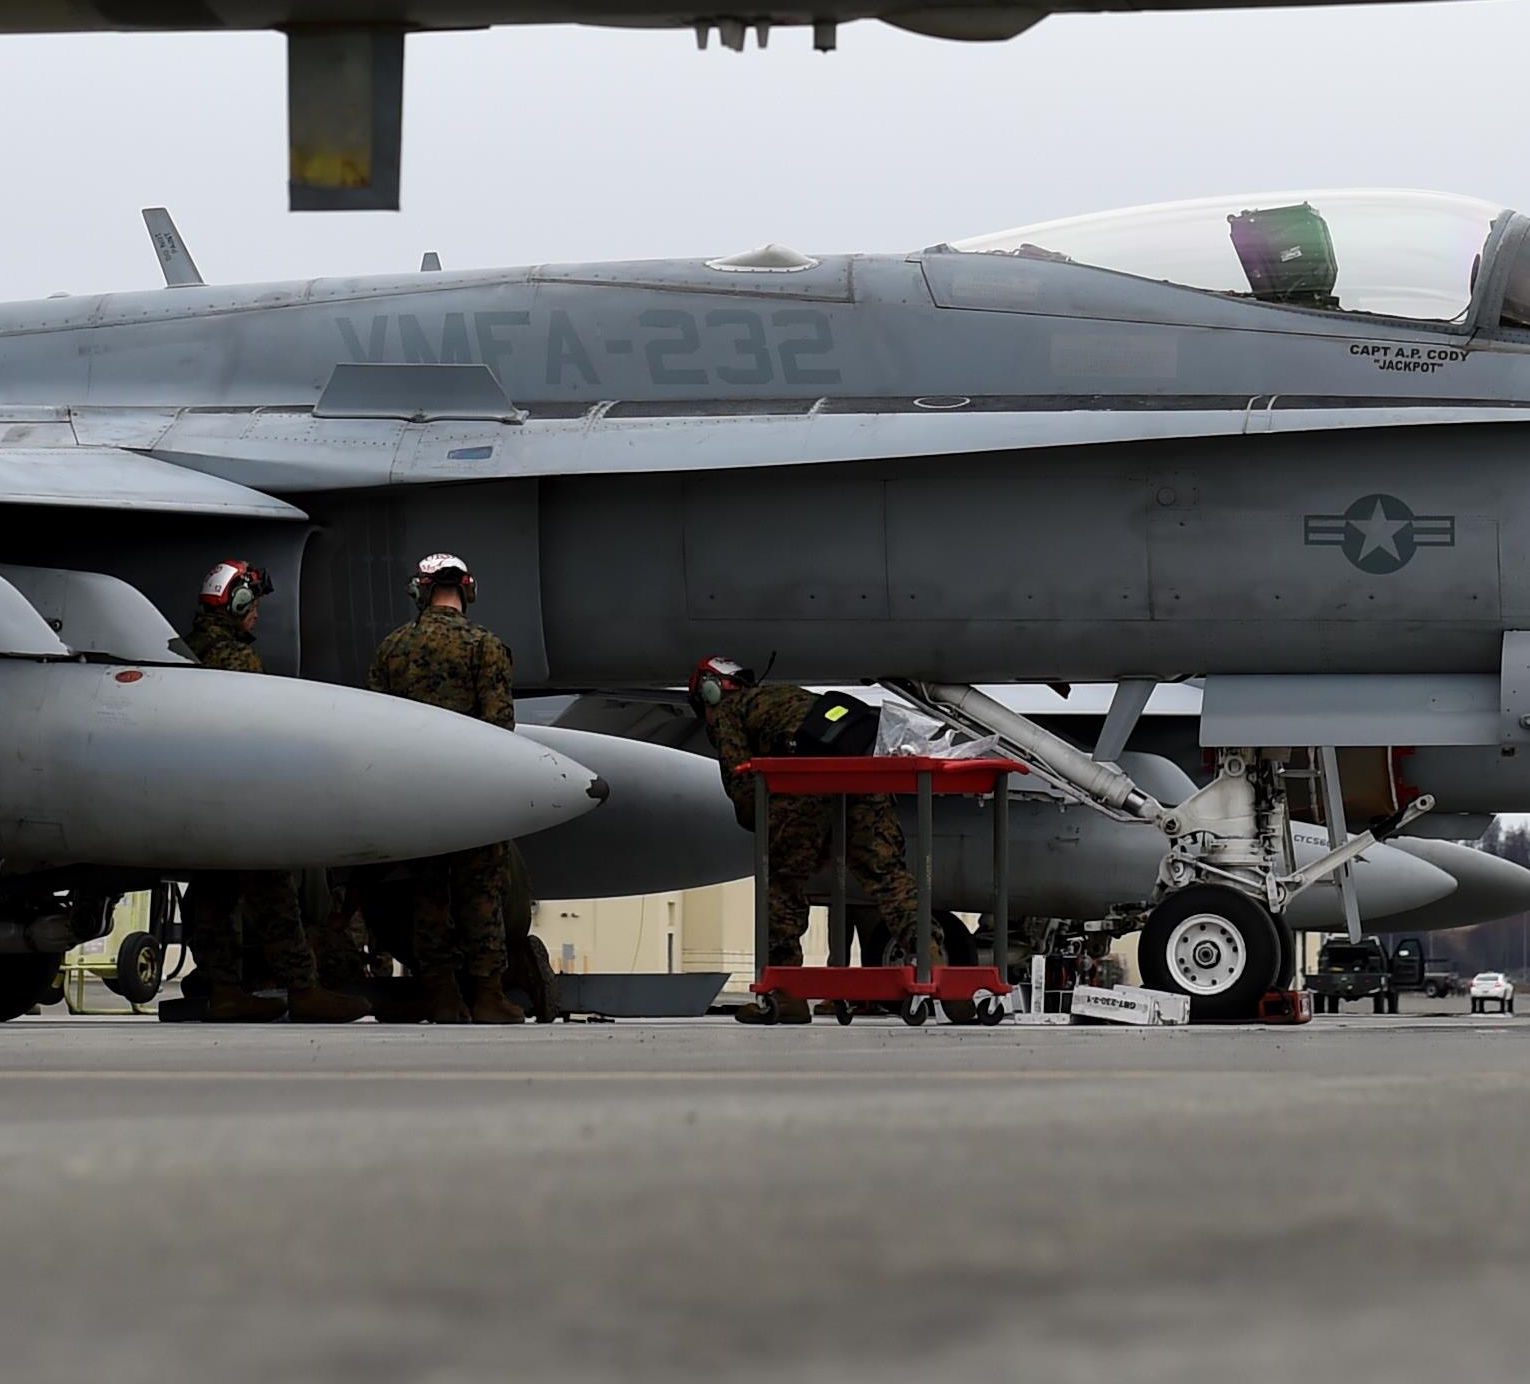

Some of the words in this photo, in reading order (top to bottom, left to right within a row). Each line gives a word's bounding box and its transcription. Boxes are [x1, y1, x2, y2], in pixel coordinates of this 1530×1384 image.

[333, 309, 843, 386] VMFA-232
[1349, 344, 1391, 357] CAPT
[1394, 347, 1422, 359] A.P.
[1427, 349, 1470, 362] CODY
[1373, 359, 1444, 373] "JACKPOT"
